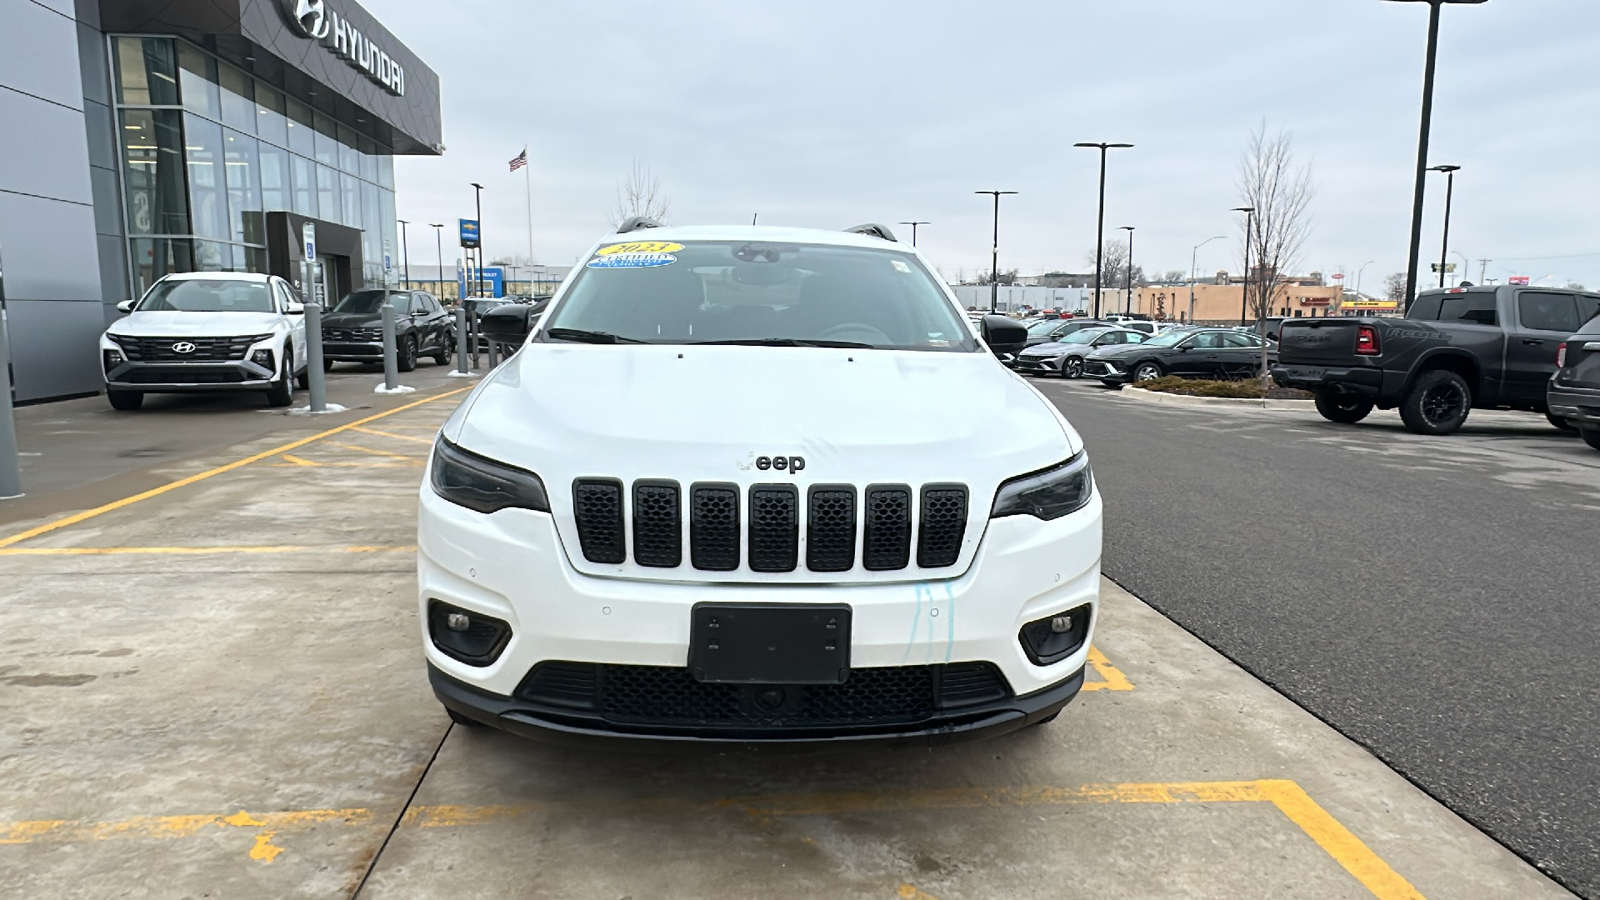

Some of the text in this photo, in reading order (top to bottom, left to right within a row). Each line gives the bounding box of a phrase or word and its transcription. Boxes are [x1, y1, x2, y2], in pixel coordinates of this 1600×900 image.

[333, 11, 404, 96] HYUNDAI
[607, 242, 670, 254] 2023
[737, 452, 806, 474] eep
